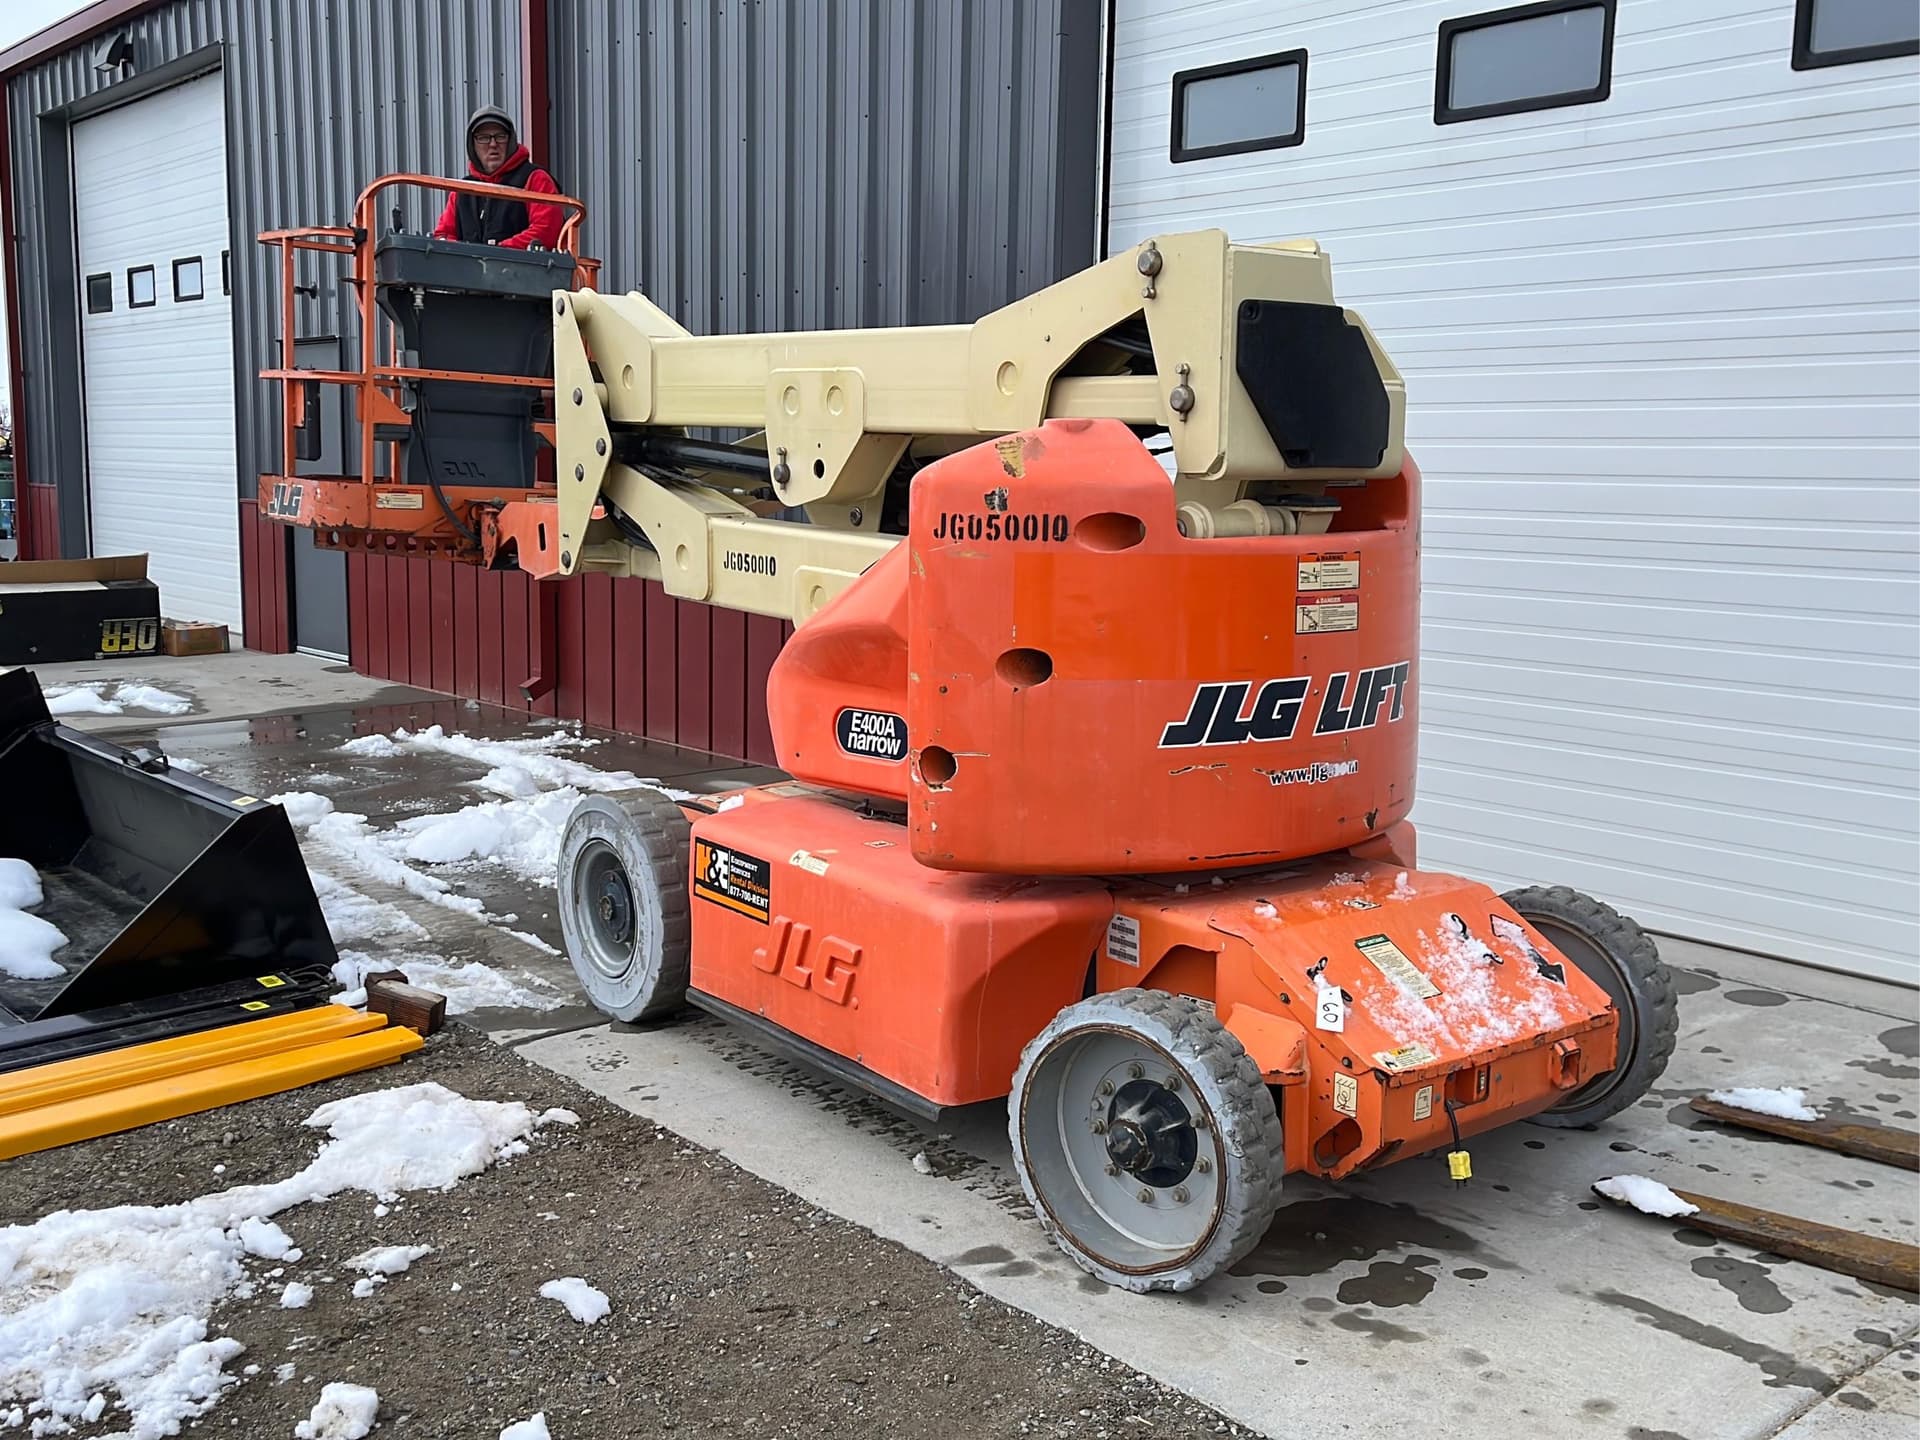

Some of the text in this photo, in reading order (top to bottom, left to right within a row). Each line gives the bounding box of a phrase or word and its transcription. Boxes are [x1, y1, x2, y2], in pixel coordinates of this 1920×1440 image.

[267, 482, 304, 518] JLG
[723, 550, 777, 576] JG050010
[1157, 660, 1410, 748] JLG LIFT
[851, 711, 896, 738] E400A
[847, 732, 902, 756] narrow
[751, 915, 863, 1008] JLG
